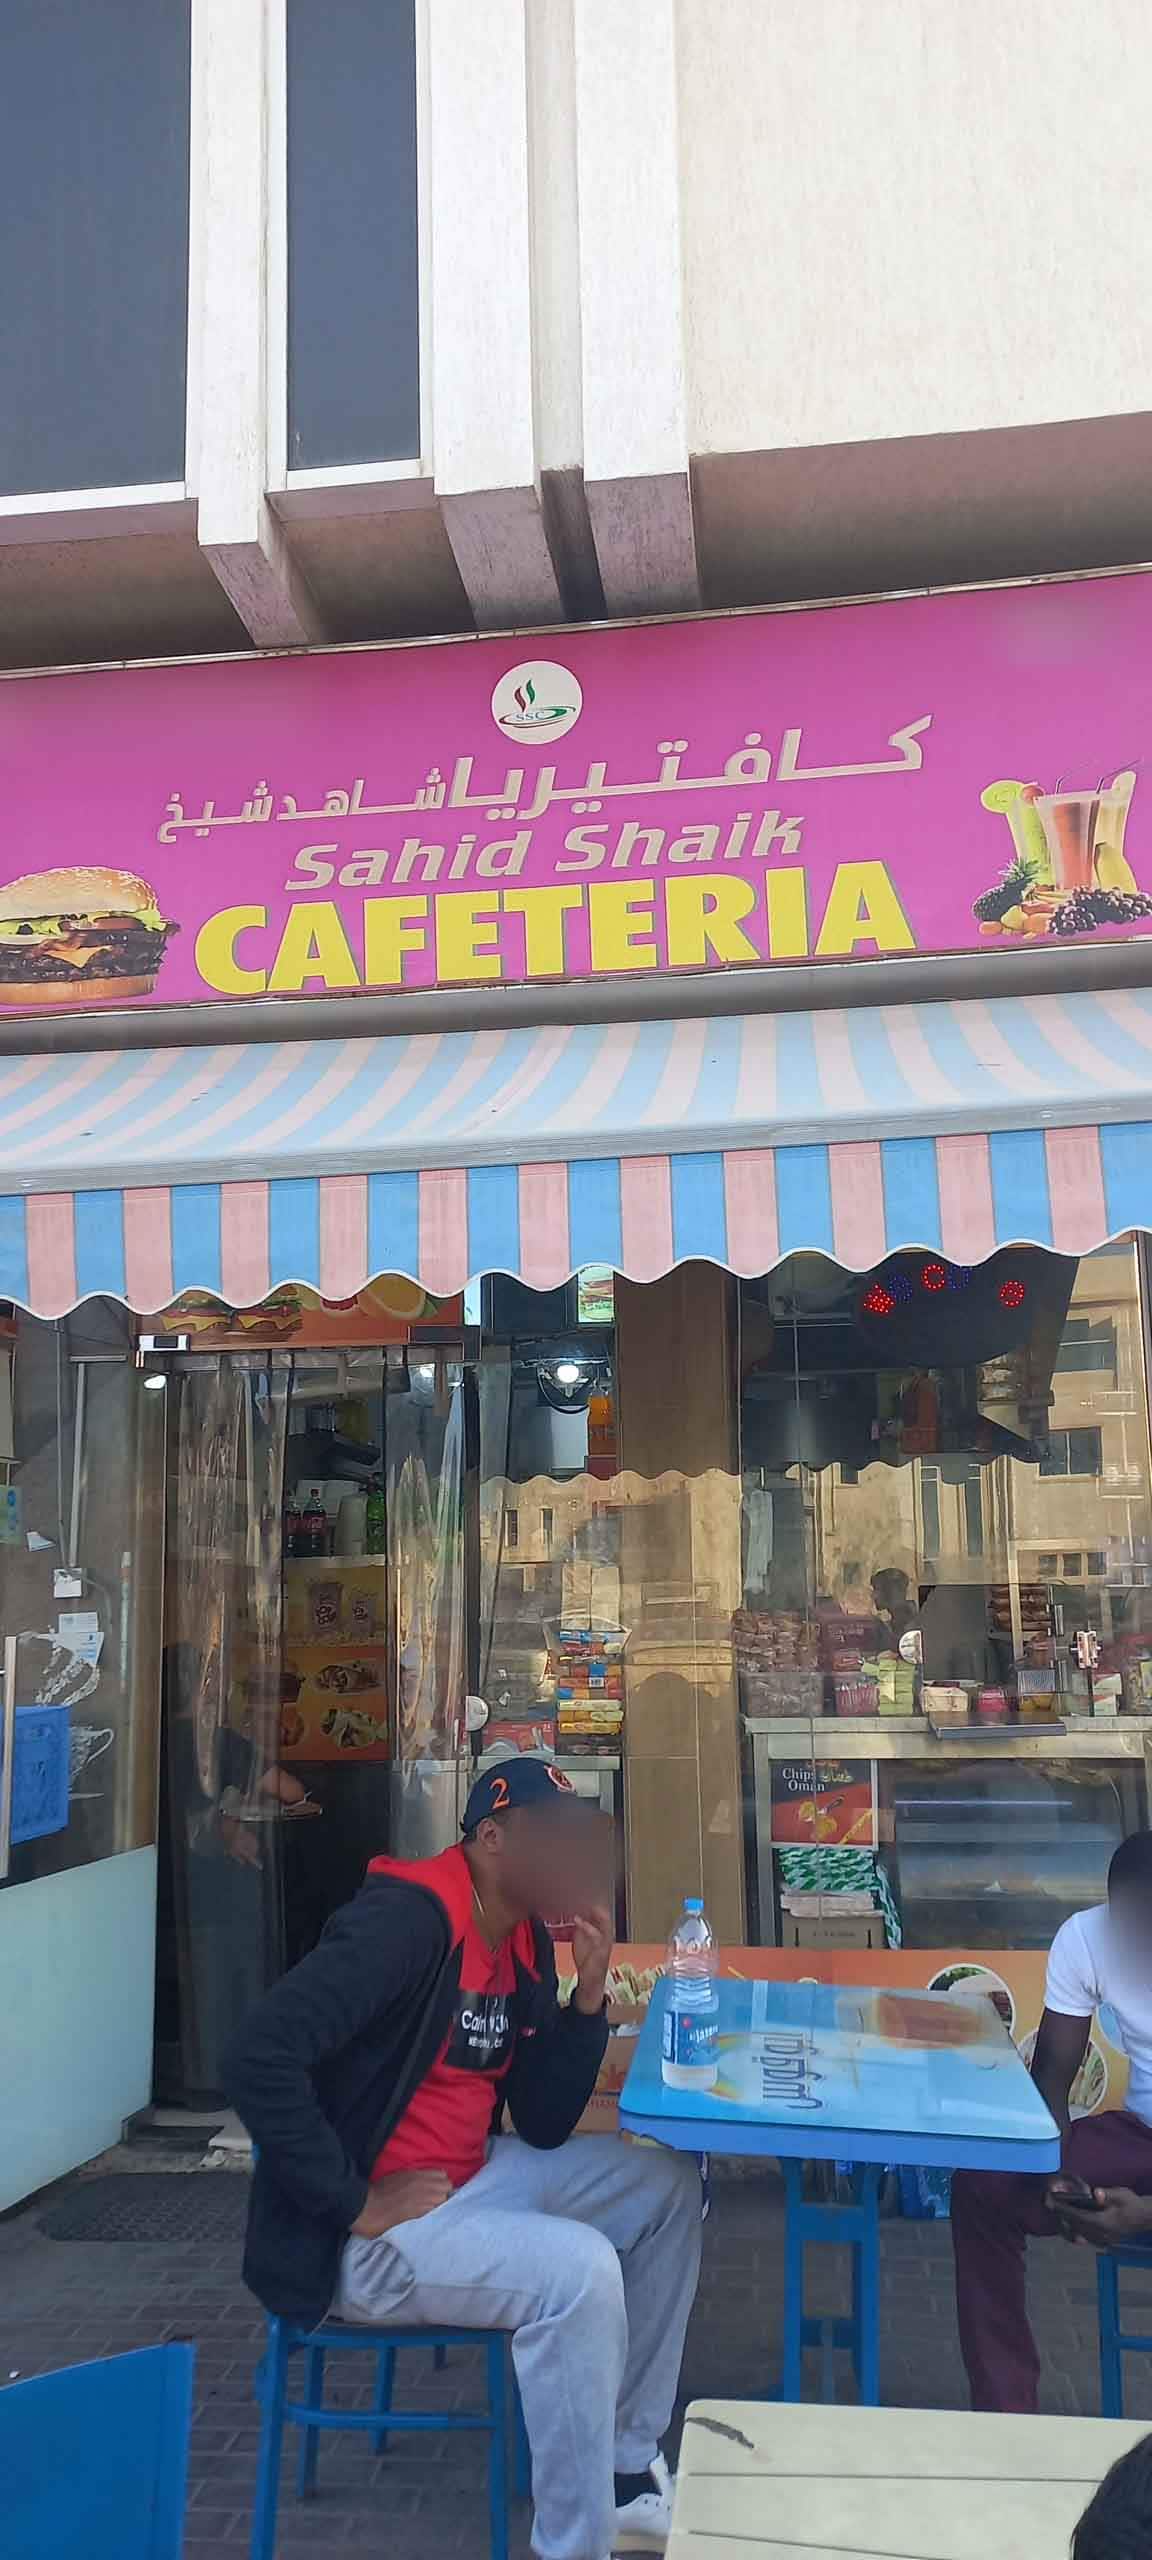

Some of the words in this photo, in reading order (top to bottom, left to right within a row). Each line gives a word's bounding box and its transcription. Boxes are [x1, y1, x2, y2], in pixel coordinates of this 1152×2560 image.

[515, 711, 545, 721] SSC
[276, 767, 447, 822] شاهد
[447, 714, 933, 822] كافتيريا
[156, 779, 274, 845] شيخ
[285, 831, 534, 892] Sahid
[554, 810, 806, 873] Shaik
[194, 860, 919, 996] CAFETERIA
[489, 1778, 510, 1809] 2
